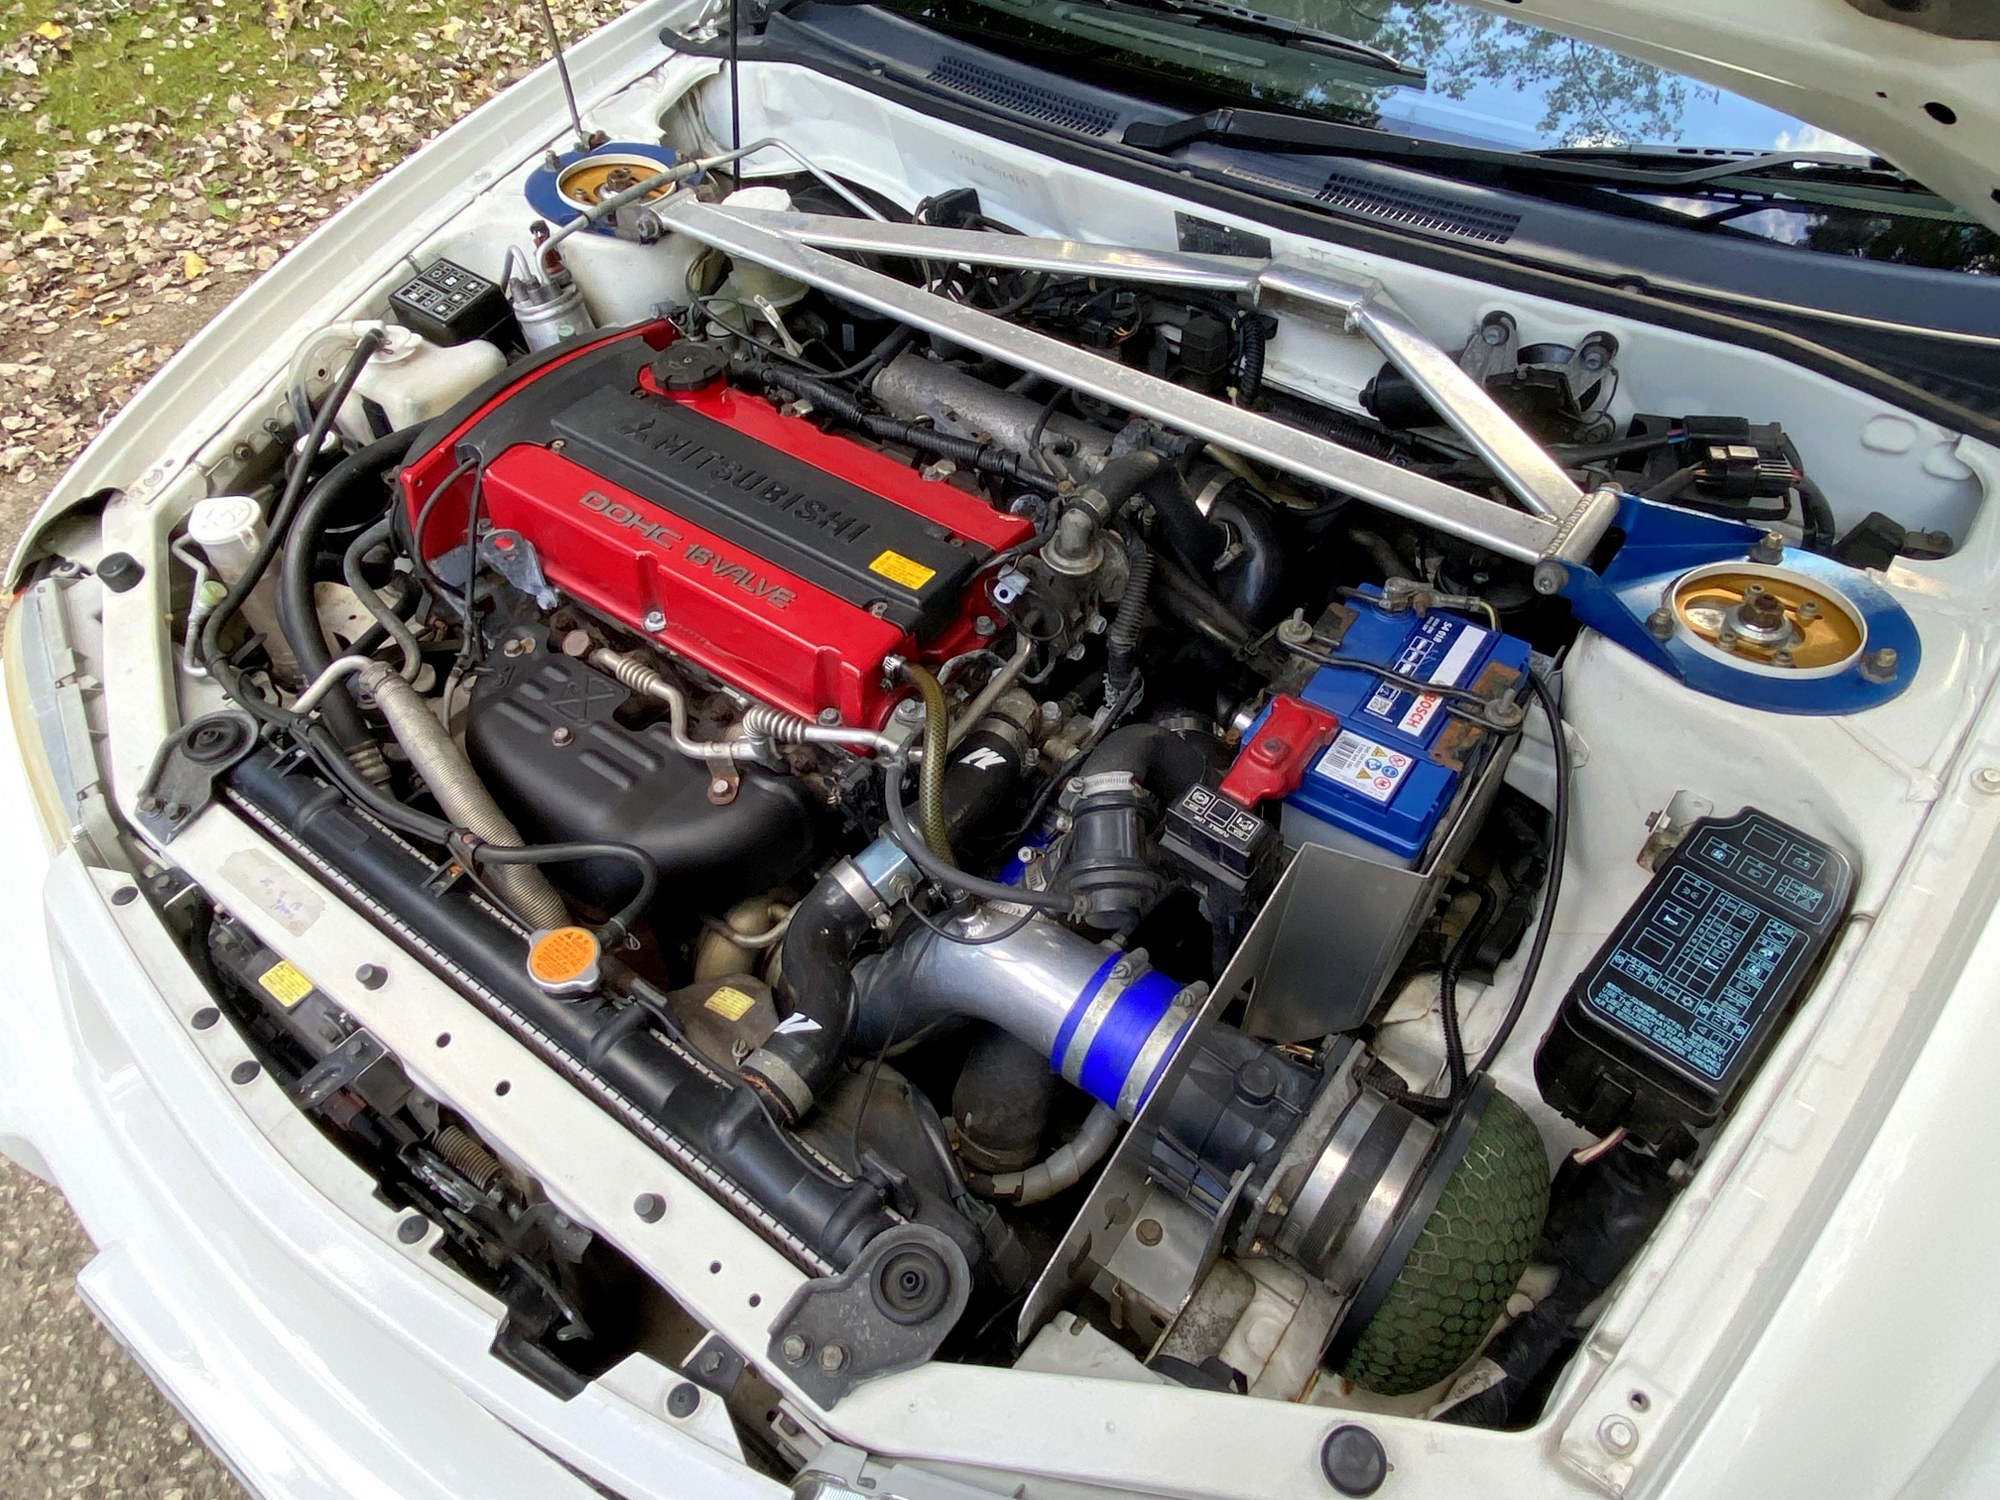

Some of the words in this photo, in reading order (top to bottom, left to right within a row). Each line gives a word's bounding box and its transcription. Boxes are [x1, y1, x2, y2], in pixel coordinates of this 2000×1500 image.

[655, 431, 870, 545] MITSUBISHI
[579, 489, 684, 550] DOHC
[1405, 691, 1437, 728] BOSCH
[1800, 886, 1823, 900] STOP
[1617, 995, 1632, 1008] THE
[1703, 1046, 1725, 1063] ONLY
